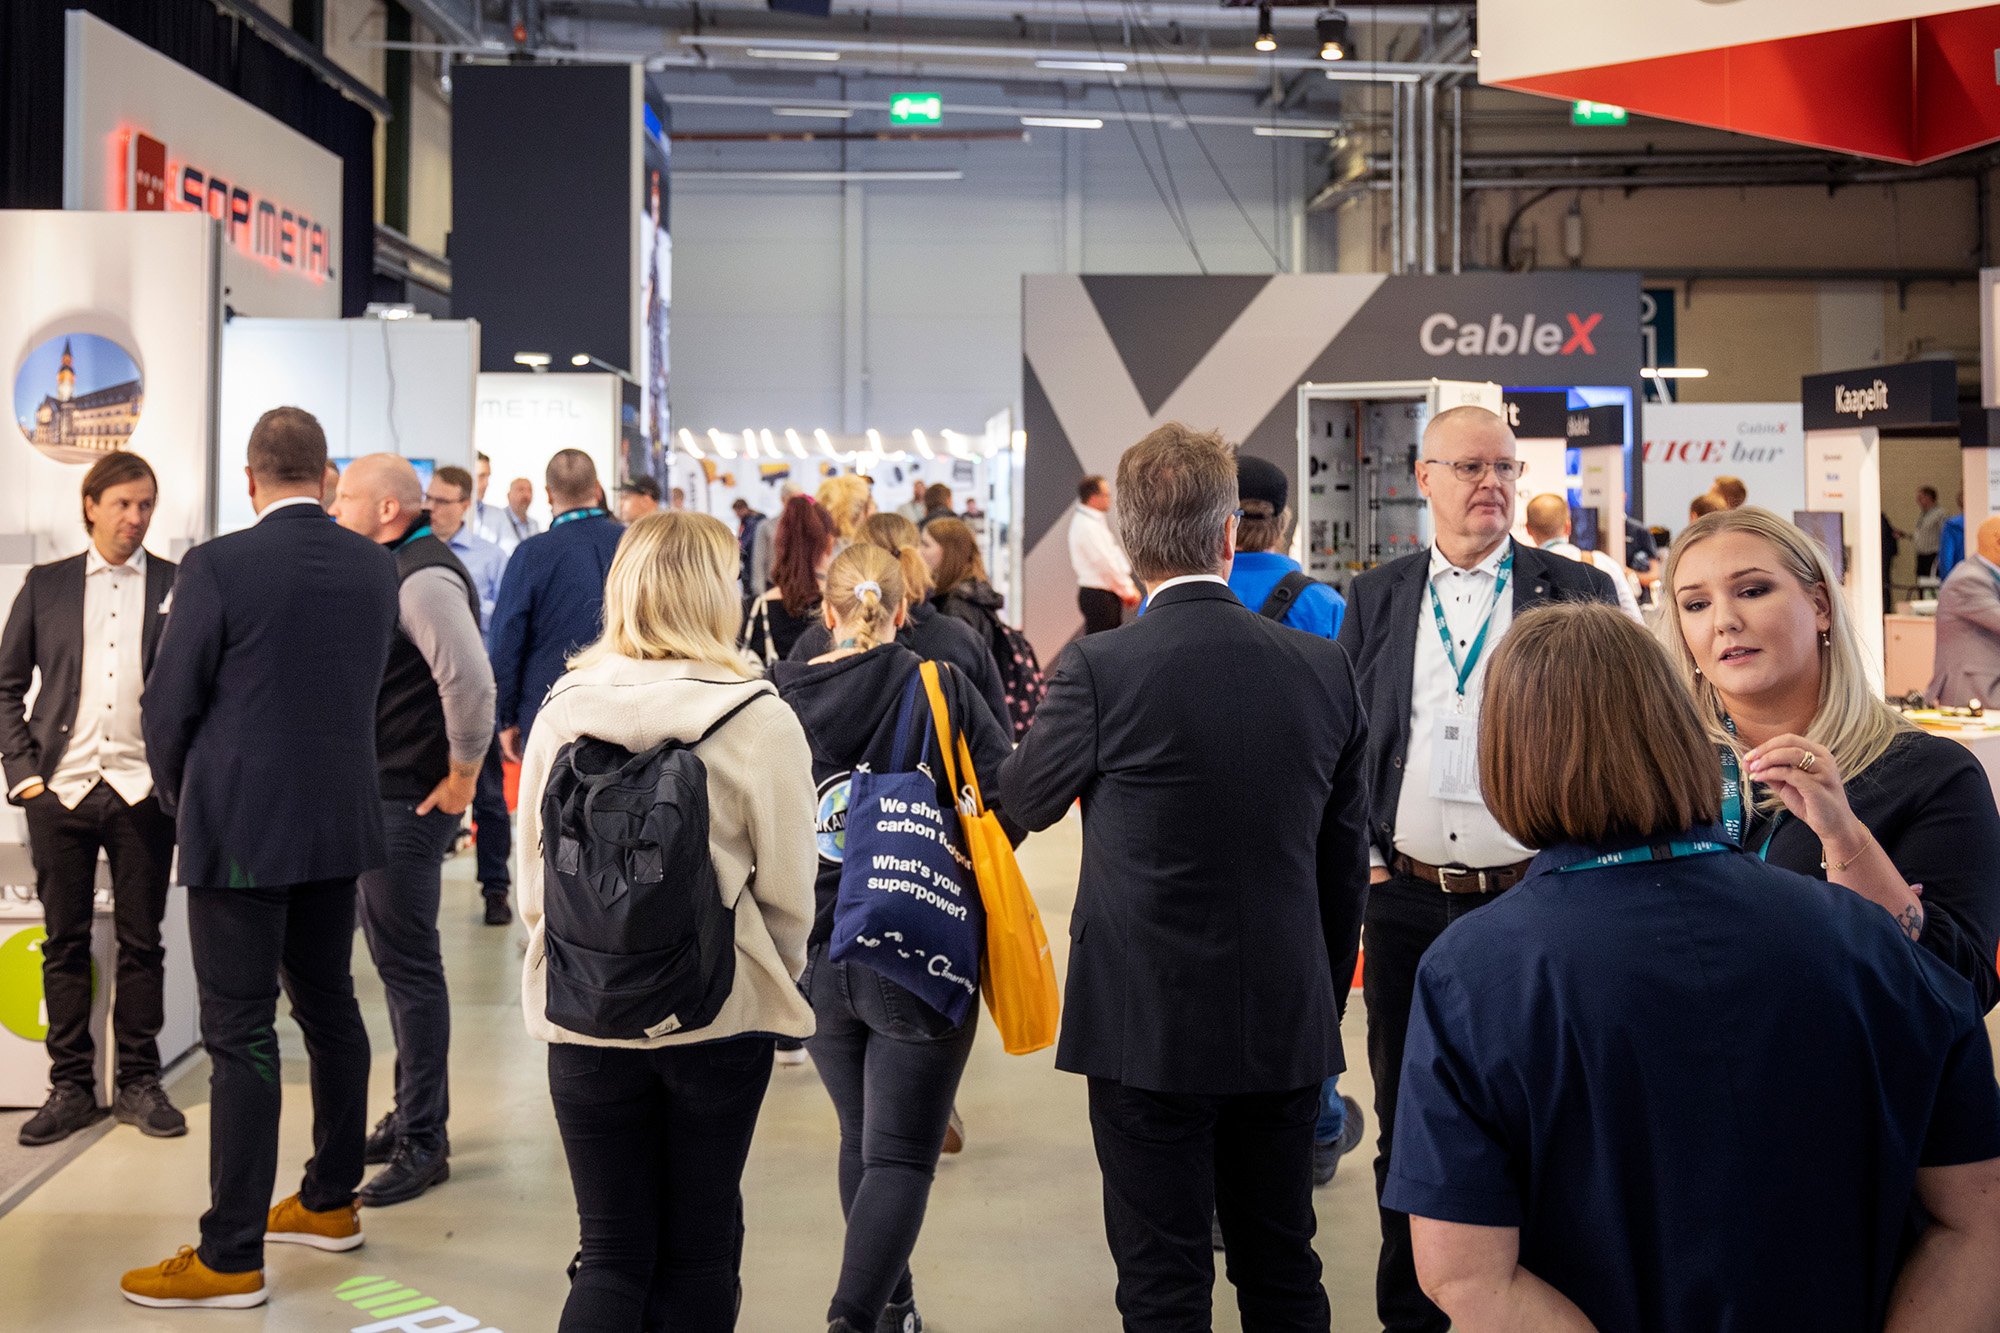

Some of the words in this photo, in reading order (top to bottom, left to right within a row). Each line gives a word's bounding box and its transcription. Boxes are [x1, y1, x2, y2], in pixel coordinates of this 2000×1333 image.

[257, 200, 335, 279] METAL
[1419, 312, 1603, 356] CableX
[480, 399, 581, 418] METAL
[1835, 379, 1888, 419] Kaapelit
[1642, 440, 1726, 463] UICE
[1732, 441, 1783, 463] bar
[879, 797, 908, 813] We
[876, 818, 936, 840] carbon
[1597, 852, 1622, 865] JONKI
[872, 855, 930, 879] What's
[932, 871, 961, 896] your
[867, 877, 968, 921] superpower?
